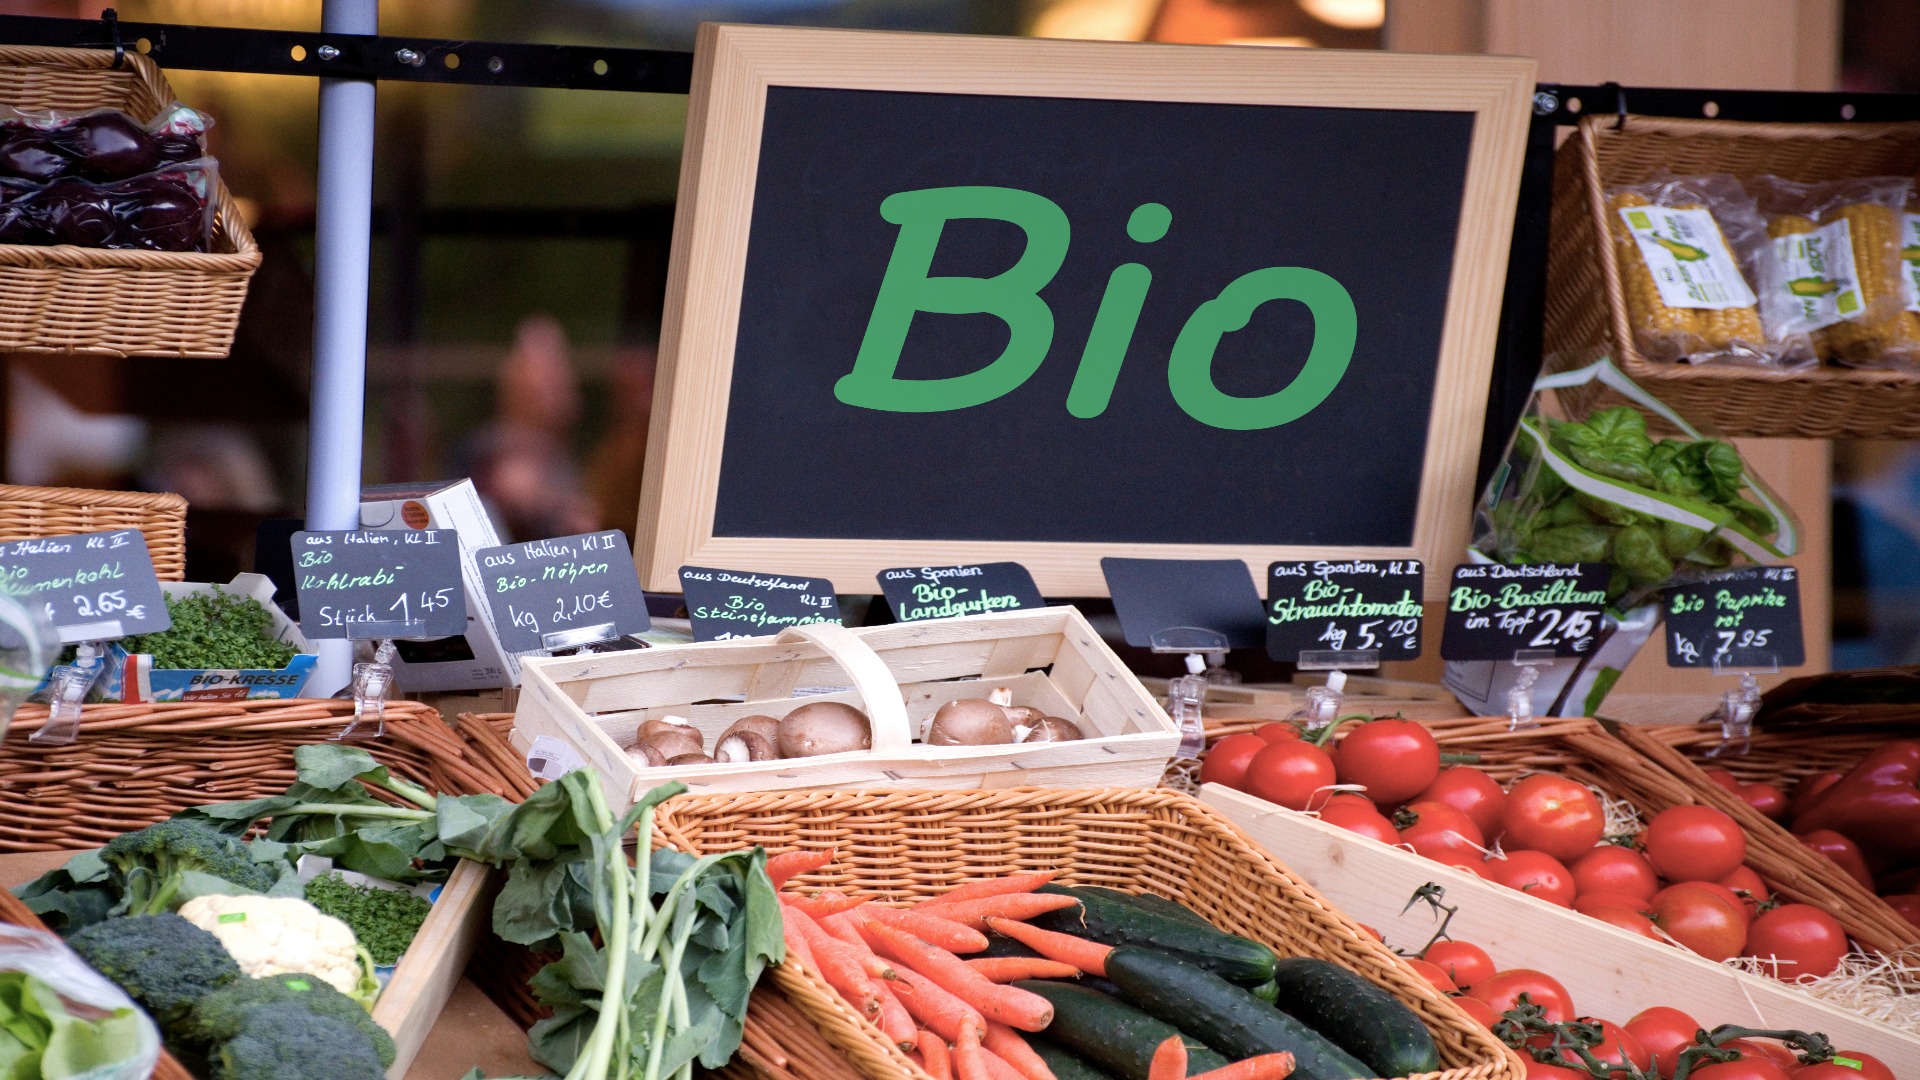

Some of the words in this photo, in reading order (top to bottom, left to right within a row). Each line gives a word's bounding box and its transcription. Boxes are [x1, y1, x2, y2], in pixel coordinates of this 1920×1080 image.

[833, 185, 1358, 430] Bio
[11, 540, 71, 556] Italien
[109, 532, 130, 549] II
[306, 536, 332, 545] aus
[425, 531, 440, 544] II
[299, 551, 333, 568] Bio
[484, 553, 516, 567] aus
[602, 534, 616, 550] II
[885, 568, 916, 580] aus
[920, 565, 984, 585] Spanien
[1274, 562, 1308, 577] aus
[1405, 561, 1420, 575] II
[1456, 566, 1487, 579] aus
[1490, 563, 1583, 579] Deutschland
[683, 570, 713, 582] aus
[717, 573, 810, 591] Deutschland
[1303, 579, 1355, 601] Bio-
[724, 595, 765, 610] Bio
[820, 596, 833, 609] II
[912, 583, 969, 603] Bio-
[1450, 578, 1607, 612] Bio-Basilikum
[1670, 593, 1705, 614] Bio
[1714, 587, 1787, 612] Paprika
[319, 604, 376, 626] Stück
[899, 588, 1021, 622] Landgurken
[1268, 589, 1424, 625] Strauchtomaten
[509, 604, 540, 633] kg
[1465, 612, 1490, 629] im
[1493, 607, 1536, 635] Topf
[1714, 610, 1744, 628] rot
[1318, 621, 1348, 651] kg
[1674, 632, 1700, 664] kg
[189, 674, 299, 685] BIO-KRESSE
